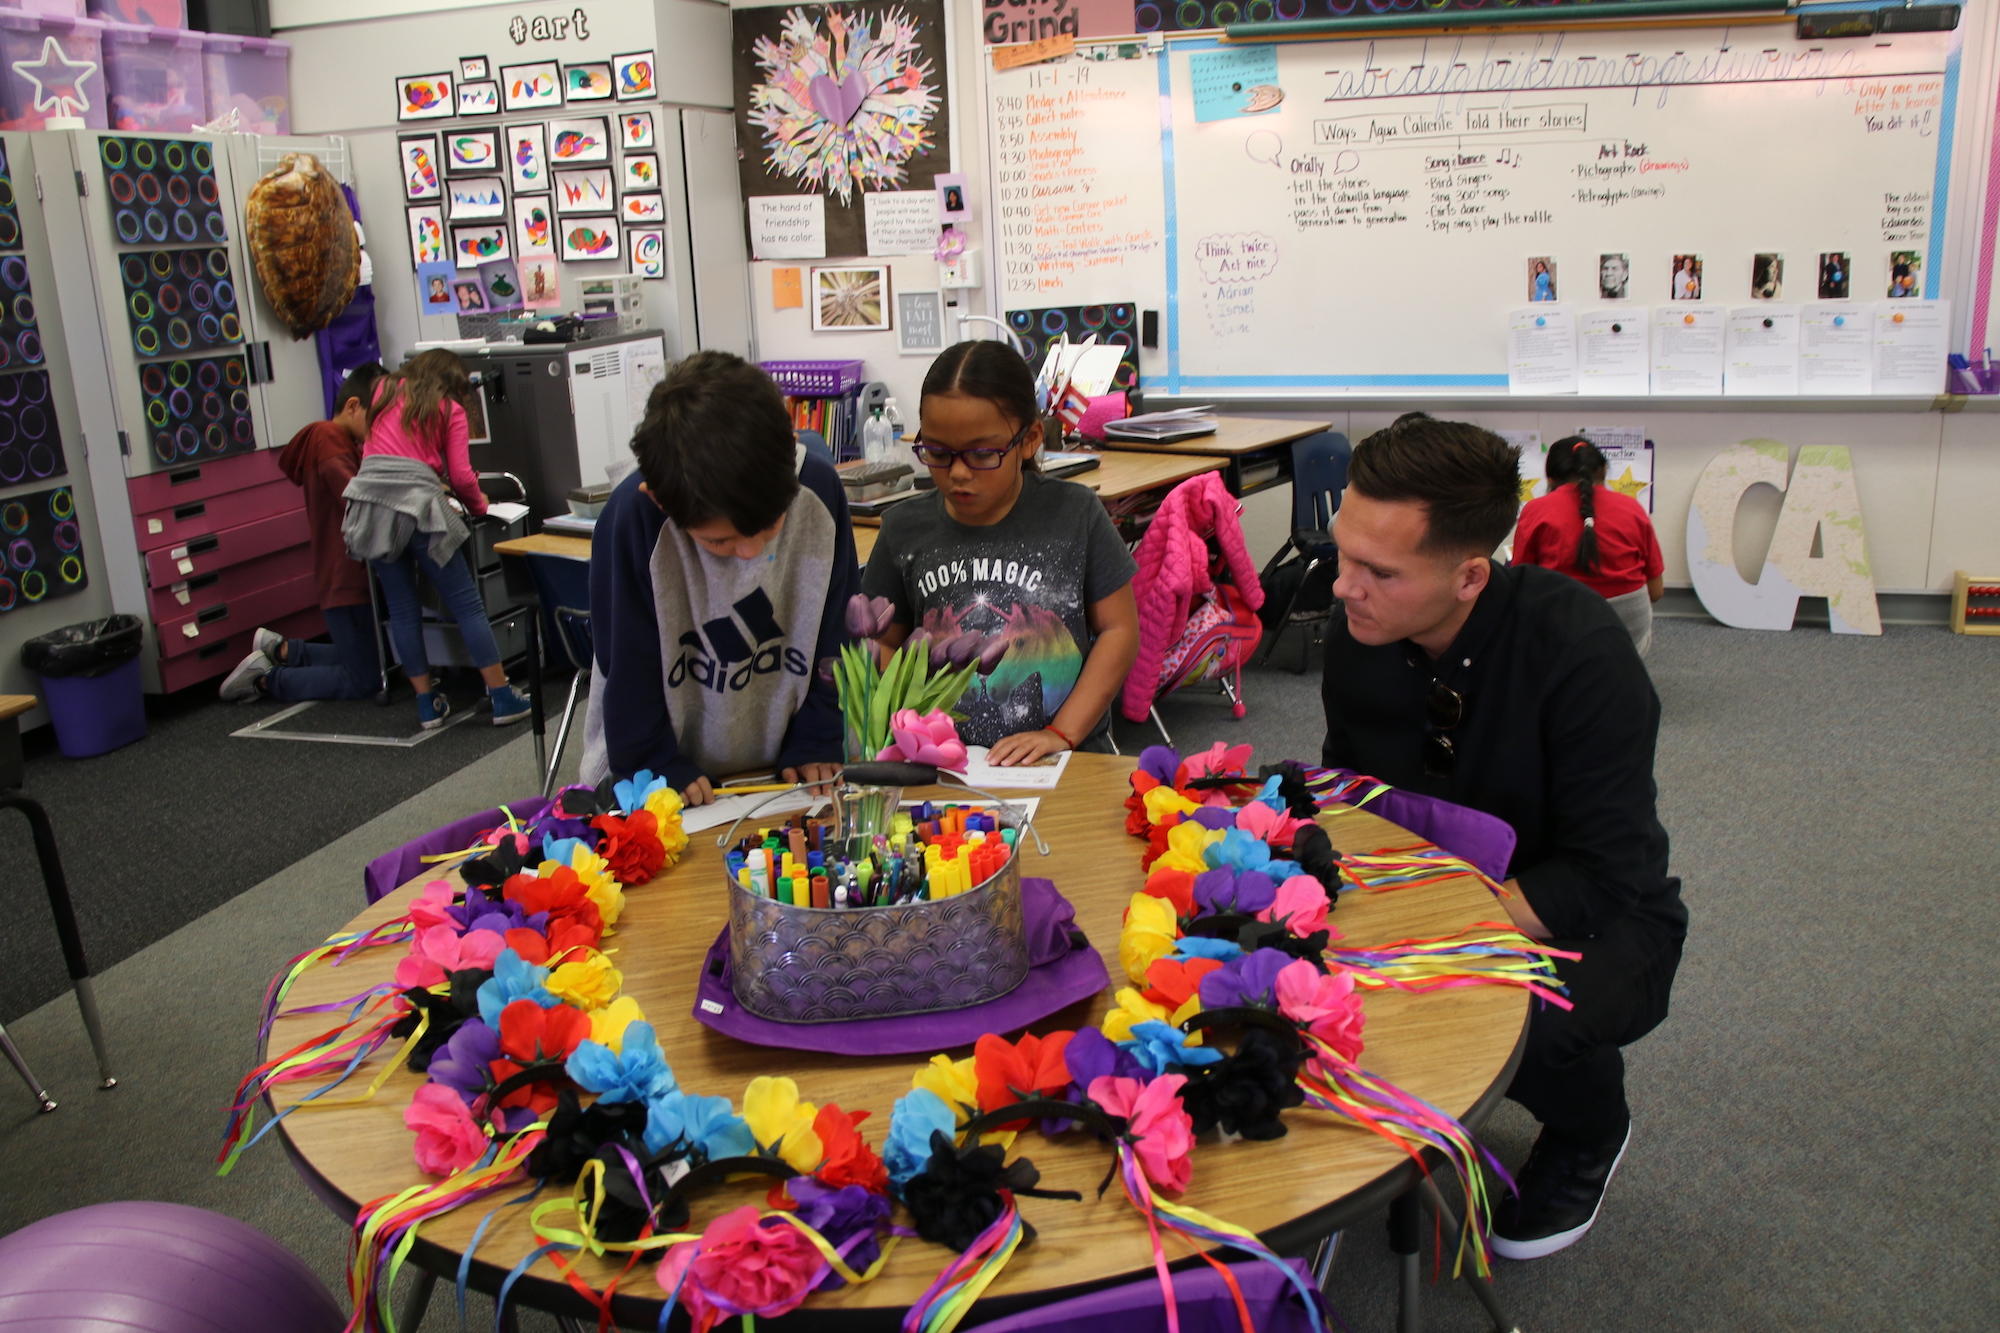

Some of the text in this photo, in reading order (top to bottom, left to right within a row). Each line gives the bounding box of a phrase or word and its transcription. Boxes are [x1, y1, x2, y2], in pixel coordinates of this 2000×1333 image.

[510, 8, 590, 45] #art
[984, 7, 1079, 43] Grind
[1320, 122, 1358, 144] Ways
[1539, 108, 1583, 128] stories
[1029, 128, 1078, 146] Assembly
[1290, 156, 1325, 177] Orally
[761, 201, 813, 213] The hand of
[764, 217, 811, 229] friendship
[1503, 209, 1521, 225] the
[760, 234, 776, 243] has
[1201, 239, 1270, 257] Think twice
[1218, 255, 1267, 272] Act nice
[1217, 286, 1254, 301] Adrian
[1686, 438, 1882, 635] CA
[917, 557, 1043, 598] 100% MAGIC
[667, 631, 809, 694] adidas
